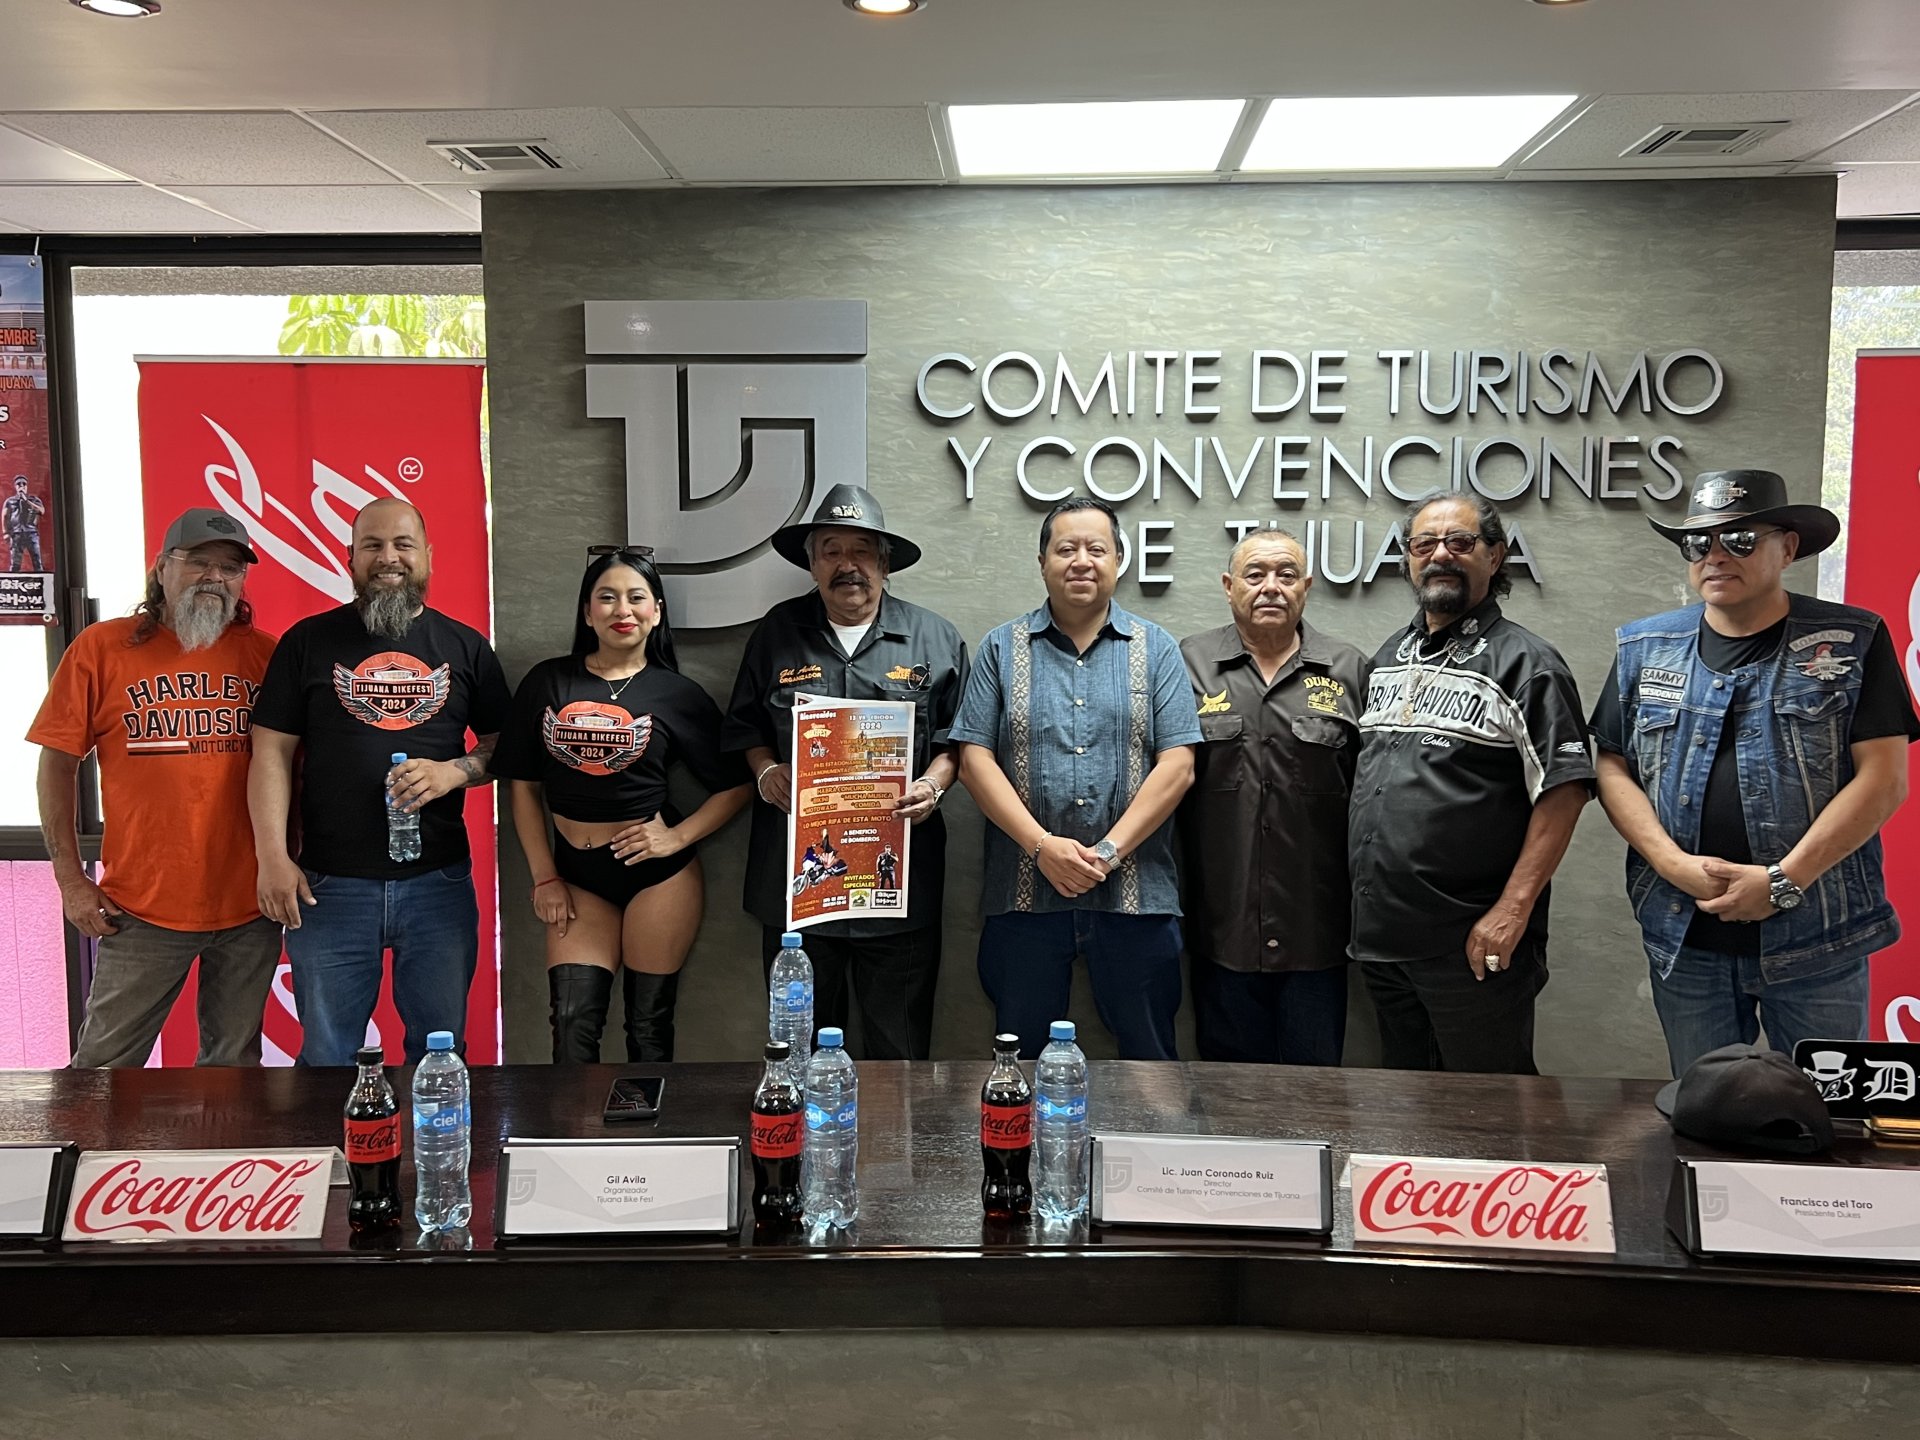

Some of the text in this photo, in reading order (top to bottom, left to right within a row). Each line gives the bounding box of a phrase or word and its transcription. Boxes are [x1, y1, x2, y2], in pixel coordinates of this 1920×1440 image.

[917, 348, 1723, 418] COMITE DE TURISMO
[948, 435, 1685, 502] Y CONVENCIONES
[1117, 519, 1545, 584] E TJUAA
[1642, 669, 1683, 685] SAMMY
[126, 672, 262, 710] HARLEY
[356, 684, 431, 694] TIJUANA BIKEFEST
[381, 699, 406, 710] 2024
[860, 722, 882, 731] 2024
[556, 730, 631, 744] TIJUANA BIKEFEST
[580, 747, 605, 758] 2024
[838, 784, 875, 793] CONCURSOS
[848, 836, 880, 844] BOMBEROS
[843, 874, 875, 882] INVITADOS
[843, 881, 875, 889] ESPECIALES
[787, 996, 805, 1007] ciel
[1066, 1100, 1086, 1116] ciel
[433, 1112, 457, 1127] ciel
[838, 1107, 856, 1123] ciel
[607, 1175, 646, 1185] Gil Avila
[1162, 1167, 1275, 1181] Lic. Juan Coronado Ruiz
[1203, 1179, 1233, 1188] Director
[73, 1158, 324, 1234] Coca-Cola
[603, 1186, 648, 1195] Organizador
[1165, 1187, 1175, 1195] de
[1176, 1187, 1202, 1196] Turismo
[1209, 1188, 1262, 1199] Convenciones
[1263, 1190, 1273, 1199] de
[1275, 1191, 1301, 1201] Tijuana
[596, 1195, 654, 1204] Tijuana Bike Fest
[1359, 1161, 1598, 1242] Coca-Cola
[1780, 1196, 1873, 1209] Francisco del Toro
[1795, 1208, 1861, 1219] Presidente Dukes
